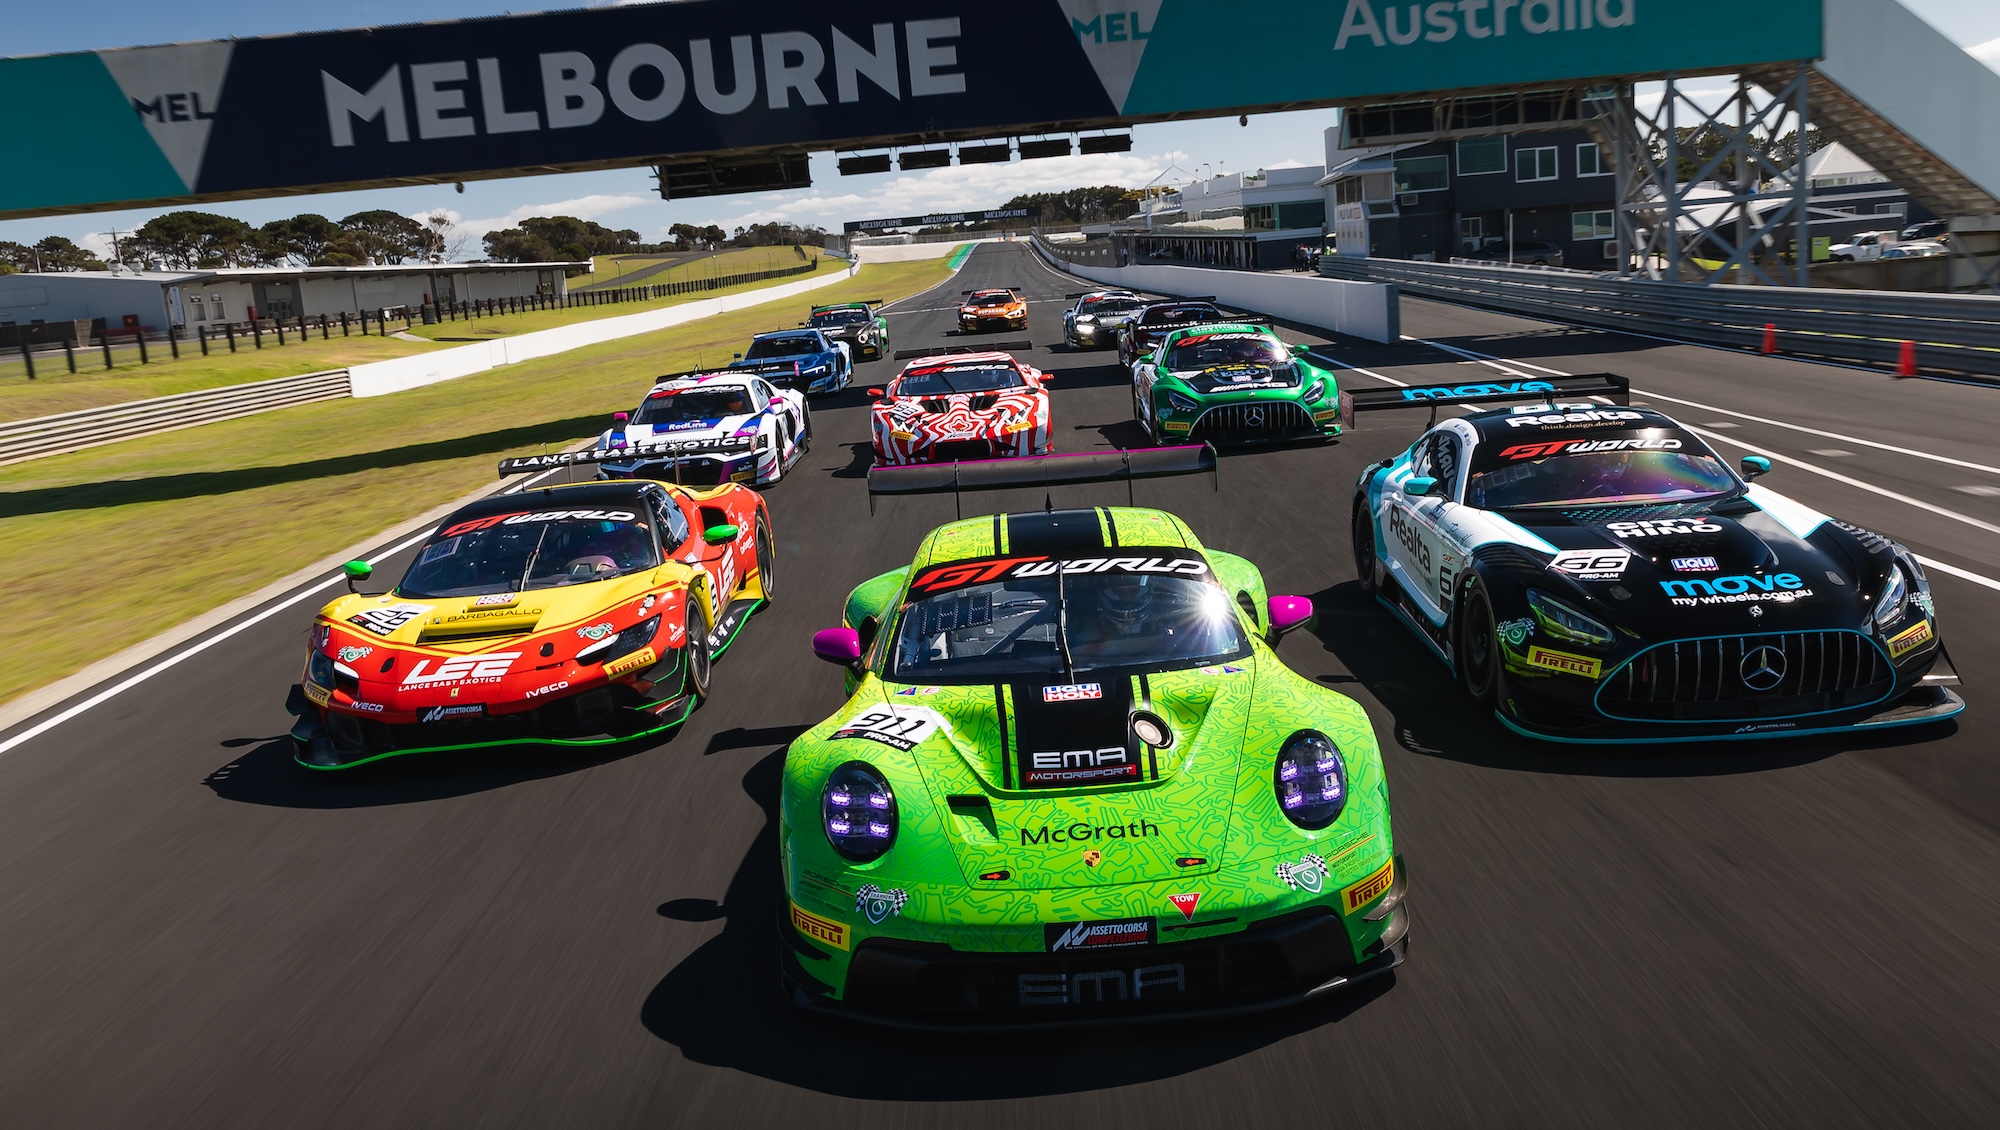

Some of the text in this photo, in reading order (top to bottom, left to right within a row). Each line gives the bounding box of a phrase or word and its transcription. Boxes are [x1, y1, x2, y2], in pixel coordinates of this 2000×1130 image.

[1071, 9, 1152, 44] MEL
[1333, 0, 1636, 50] Australia
[321, 16, 967, 147] MELBOURNE
[130, 91, 217, 124] MEL
[922, 213, 965, 224] MELBOURNE
[984, 208, 1028, 219] MELBOURNE
[859, 219, 903, 230] MELBOURNE
[1402, 381, 1554, 400] move
[669, 421, 707, 431] RedLine
[1503, 410, 1644, 428] Realta
[512, 450, 588, 468] LANCE
[592, 444, 652, 458] EAST
[653, 437, 751, 452] EXOTICS
[1606, 517, 1708, 531] CITY
[1613, 524, 1723, 539] HINO
[1390, 504, 1432, 575] Realta
[1555, 555, 1627, 570] 66
[1674, 557, 1715, 569] LIQUI
[1659, 573, 1804, 597] move
[1671, 588, 1814, 607] my wheels.com.au
[448, 608, 542, 622] BARBAGALLO
[1892, 625, 1929, 653] PIRELLI
[402, 652, 523, 685] LEE
[608, 651, 652, 675] PIRELLI
[1534, 650, 1595, 674] PIRELLI
[398, 676, 502, 691] LANCE EAST EXOTICS
[525, 681, 569, 699] IVECO
[1046, 683, 1098, 693] LIQUI
[1048, 690, 1100, 700] MOLY
[351, 701, 384, 712] IVECO
[851, 713, 926, 736] 911
[863, 731, 911, 750] PRO-AM
[1033, 747, 1127, 768] EMA
[1030, 766, 1132, 780] MOTORSPORT
[1021, 819, 1159, 846] McGrath
[1324, 831, 1370, 860] PORSCHE
[803, 869, 852, 891] PORSCHE
[1349, 864, 1392, 909] PIRELLI
[1174, 894, 1195, 903] TOW
[792, 906, 844, 946] PIRELLI
[1090, 921, 1149, 936] ASSETTO CORSA
[1087, 931, 1148, 945] COMPETIZIONE
[1018, 962, 1186, 1005] EMA
